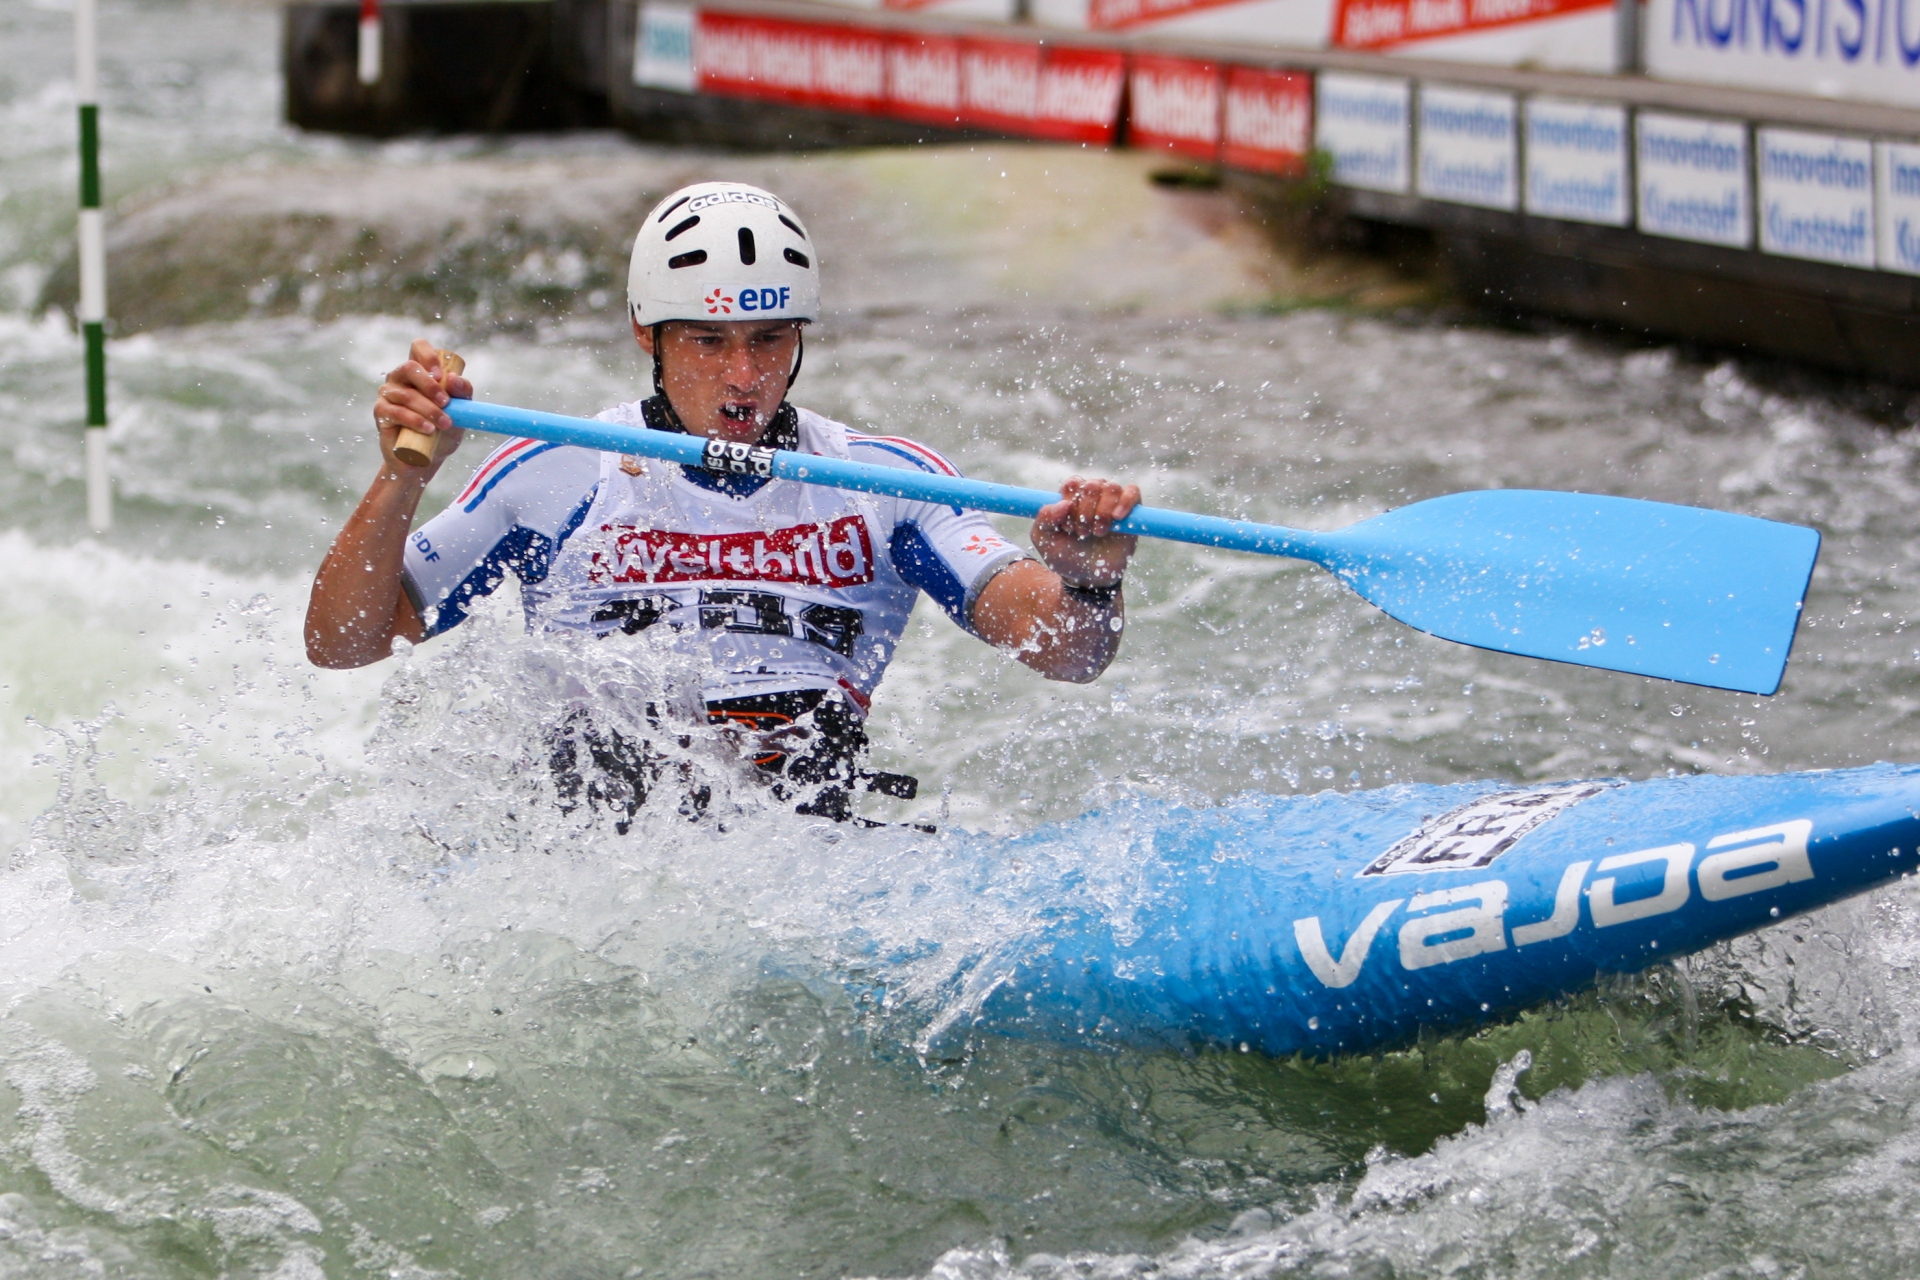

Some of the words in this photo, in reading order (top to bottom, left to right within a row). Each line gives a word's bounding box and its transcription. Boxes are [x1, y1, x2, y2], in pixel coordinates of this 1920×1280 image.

[1760, 133, 1867, 189] Innovation
[688, 191, 779, 212] adidas
[603, 522, 866, 580] Weltbild
